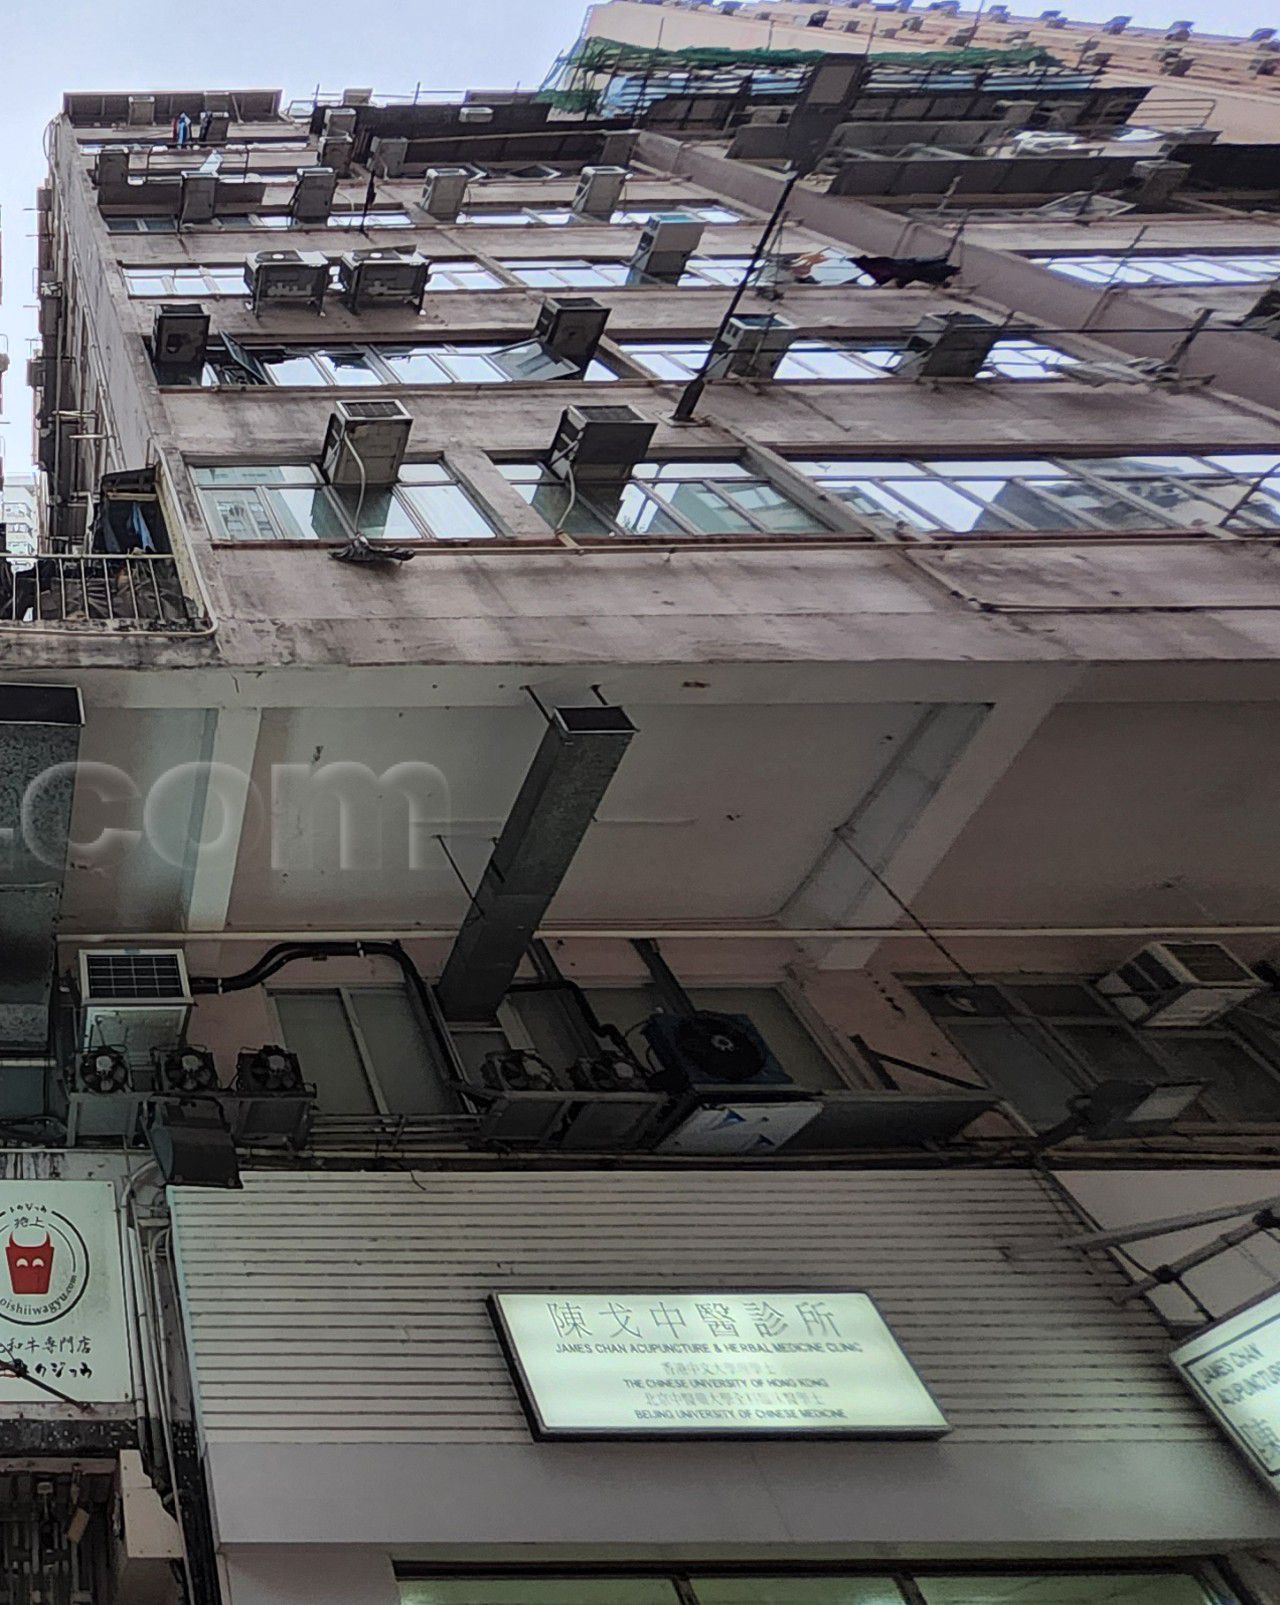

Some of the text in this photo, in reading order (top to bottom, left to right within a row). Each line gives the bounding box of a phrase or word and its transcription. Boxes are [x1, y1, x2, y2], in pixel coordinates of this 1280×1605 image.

[546, 1300, 842, 1339] 陳戈中醫診所
[555, 1343, 863, 1354] JAMES CHAN ACUPUNCTURE & HERBAL MEDICINE CLINIC
[623, 1378, 829, 1388] THE CHINESE UNIVERSITY OF HONG KONG
[676, 1409, 736, 1419] UNIVERSITY
[738, 1409, 751, 1419] OF
[755, 1409, 798, 1419] CHINESE
[800, 1409, 847, 1419] MEDICINE
